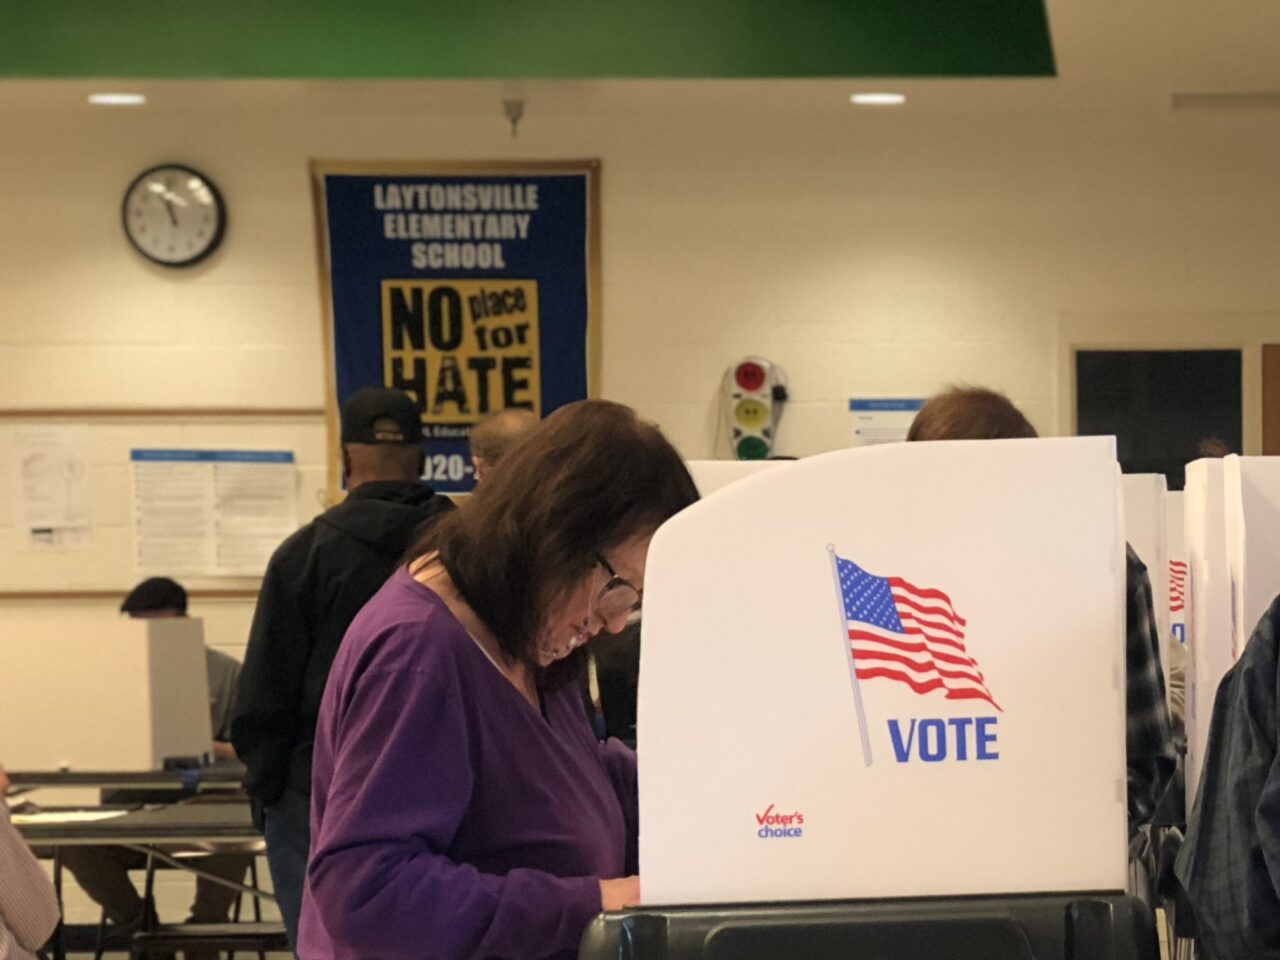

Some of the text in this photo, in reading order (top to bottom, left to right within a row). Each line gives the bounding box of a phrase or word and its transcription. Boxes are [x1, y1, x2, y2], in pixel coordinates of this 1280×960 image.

[373, 184, 540, 211] LAYTONSVILLE
[383, 213, 531, 240] ELEMENTARY
[410, 242, 506, 270] SCHOOL
[389, 286, 528, 352] NO place
[475, 322, 530, 351] for
[391, 355, 535, 415] HATE
[886, 716, 1000, 763] VOTE
[755, 803, 805, 826] Voter's
[757, 825, 803, 839] choice
